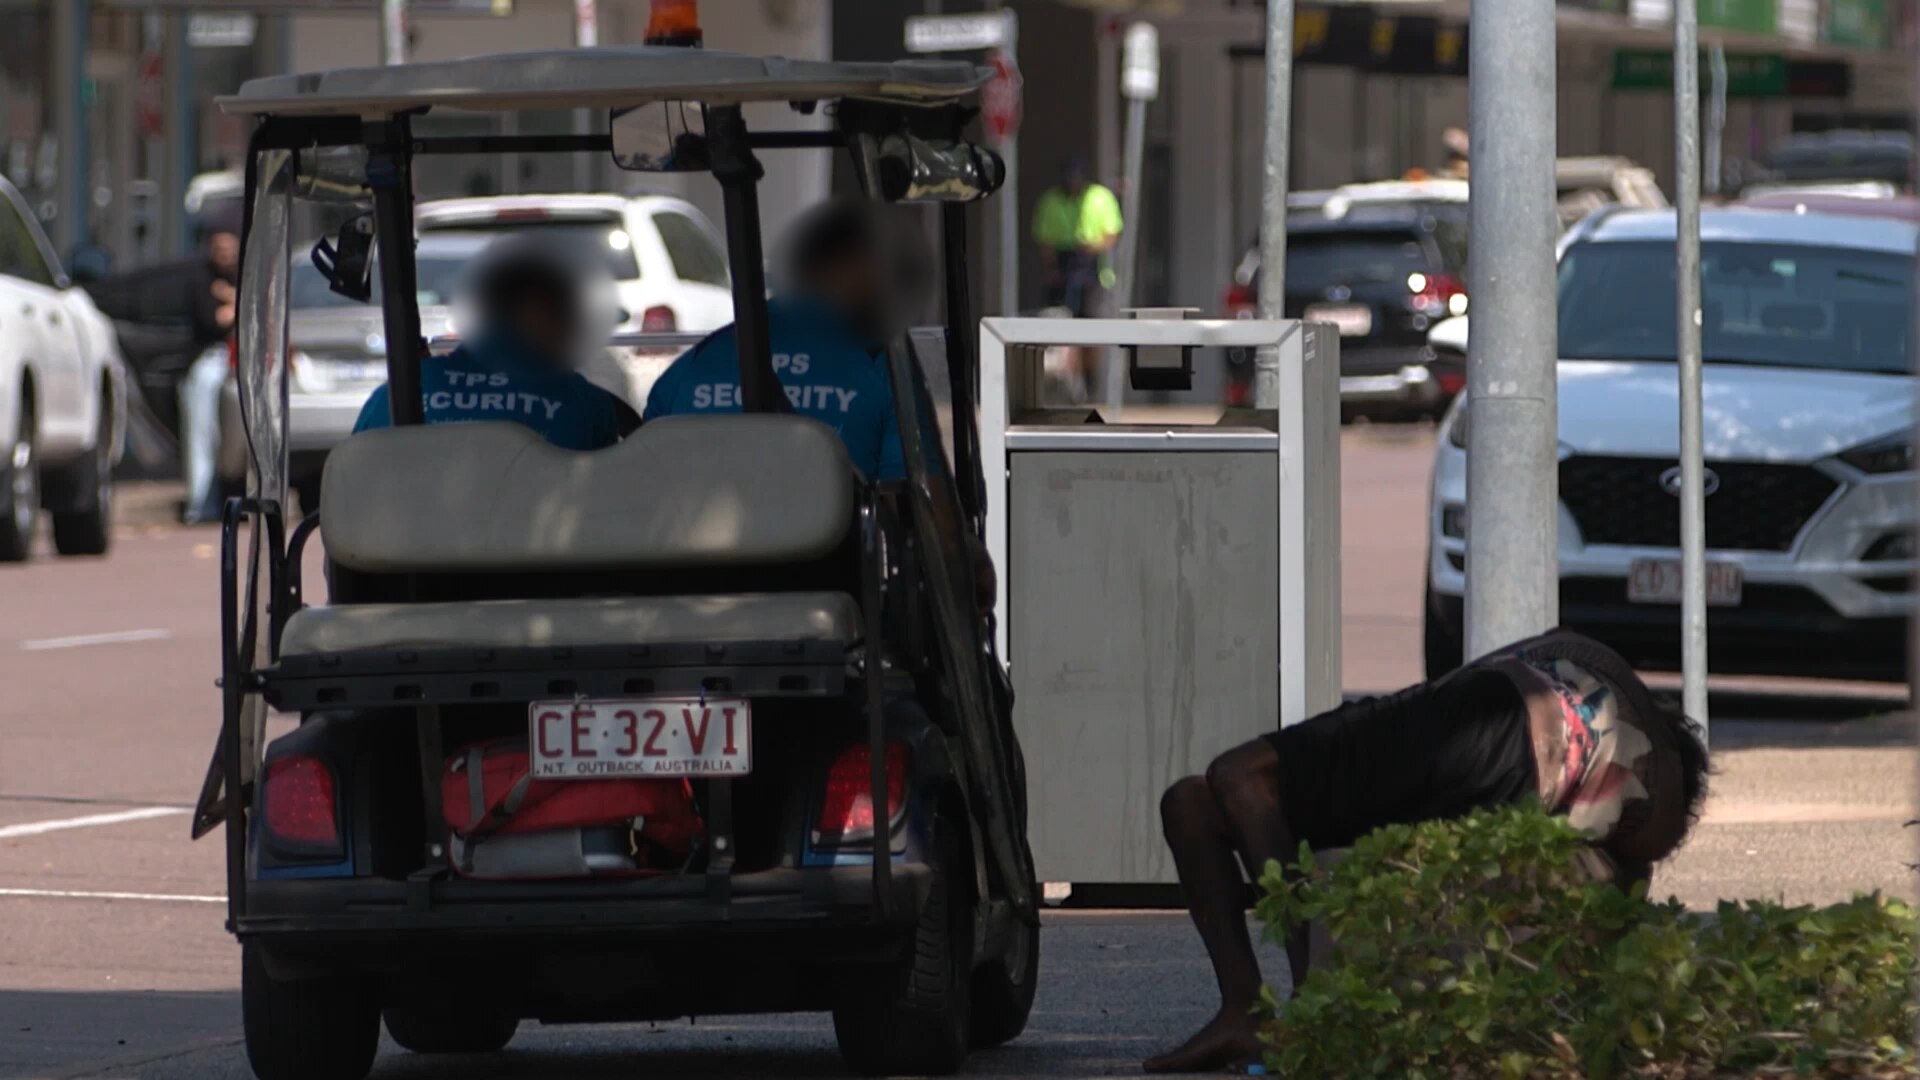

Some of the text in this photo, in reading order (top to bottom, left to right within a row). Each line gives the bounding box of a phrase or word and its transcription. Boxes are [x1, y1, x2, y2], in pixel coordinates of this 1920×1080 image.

[771, 353, 811, 375] PS
[444, 370, 510, 387] TPS
[543, 760, 732, 774] N.T. OUTBACK AUSTRALIA
